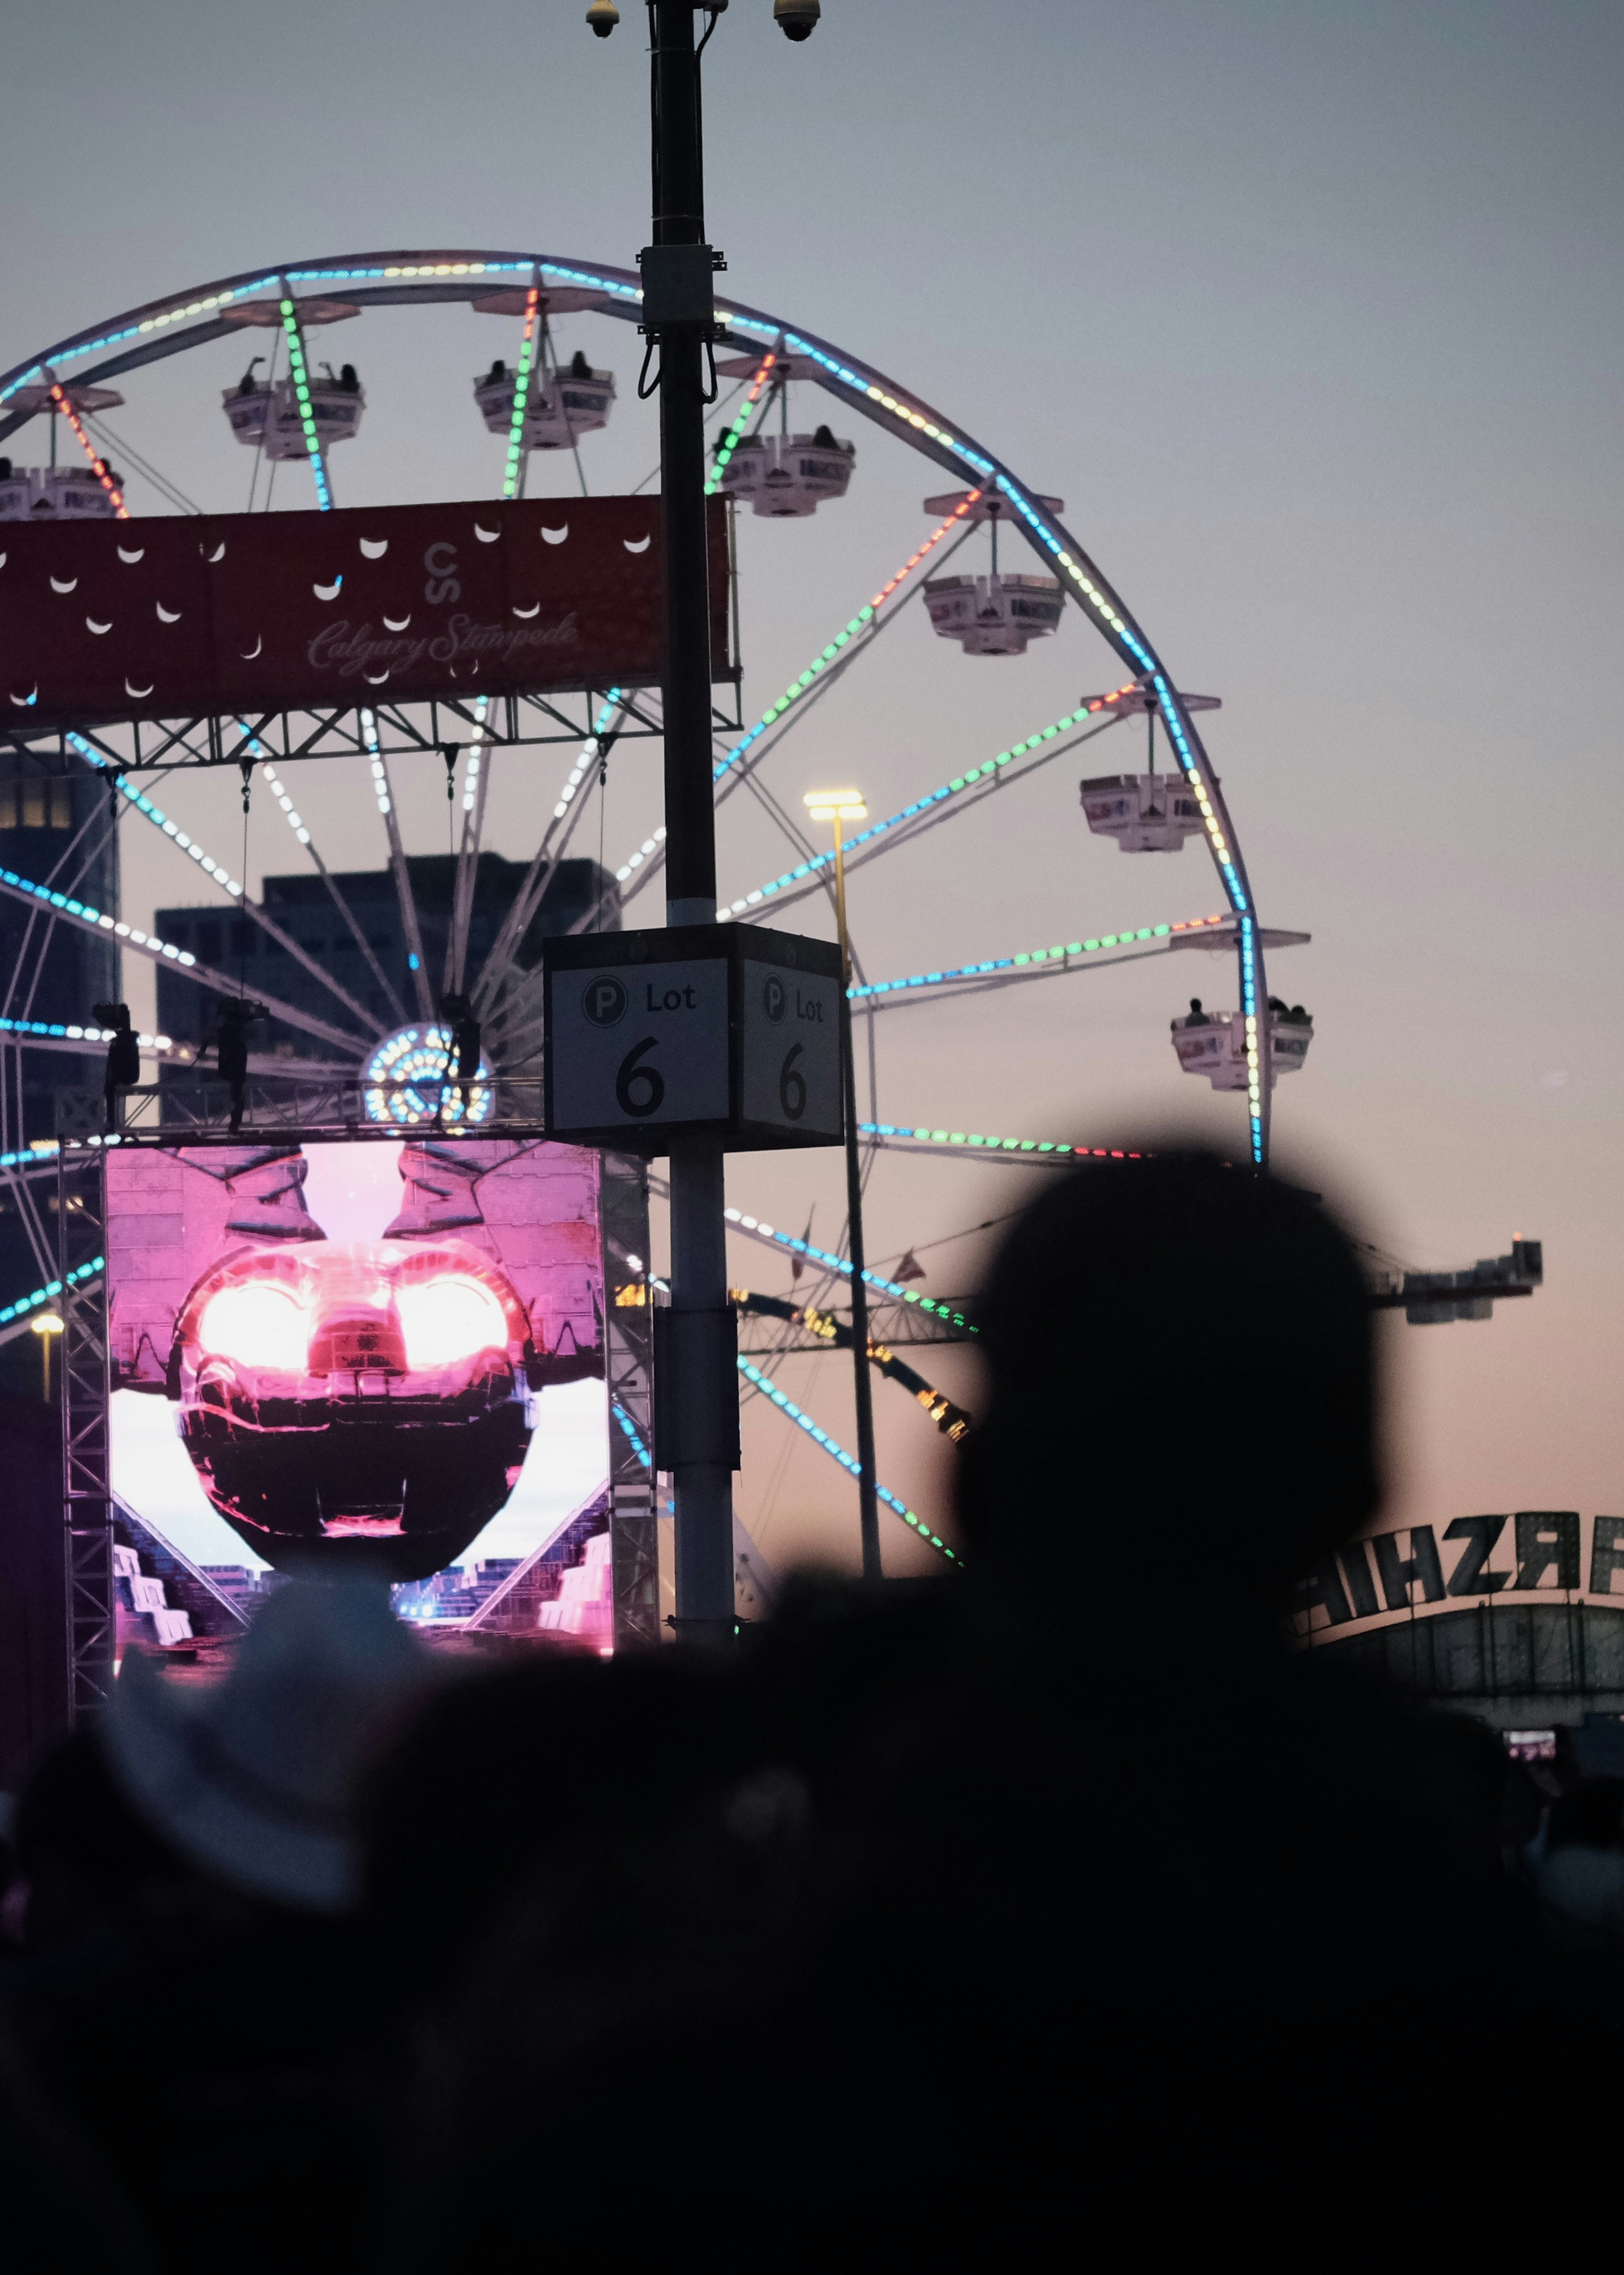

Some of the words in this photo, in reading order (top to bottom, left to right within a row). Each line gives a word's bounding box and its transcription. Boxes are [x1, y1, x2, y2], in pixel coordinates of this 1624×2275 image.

[307, 620, 428, 676] Calgary
[429, 613, 578, 662] Stampede
[647, 984, 697, 1011] Lot
[797, 990, 823, 1022] Lot
[616, 1036, 665, 1118] 6
[780, 1043, 807, 1120] 6
